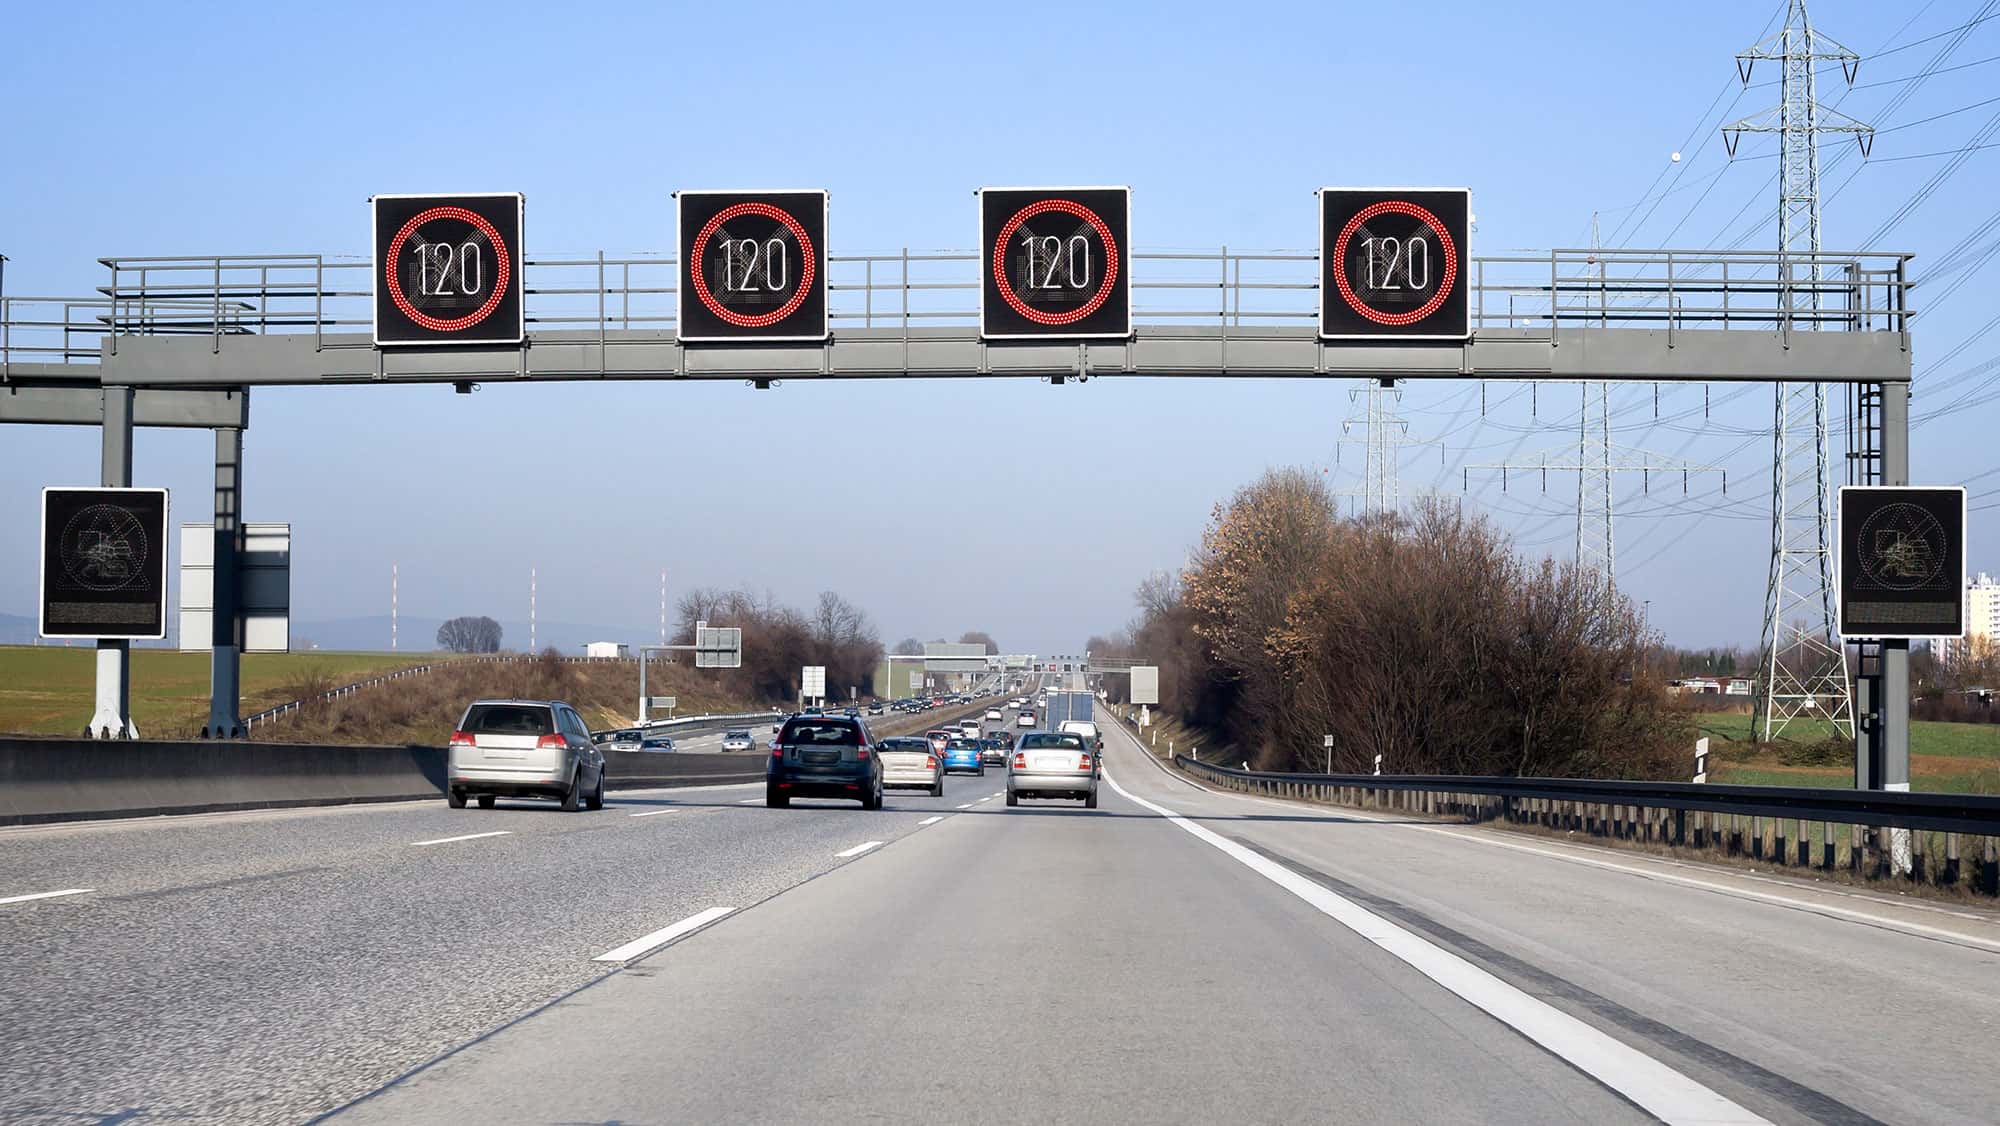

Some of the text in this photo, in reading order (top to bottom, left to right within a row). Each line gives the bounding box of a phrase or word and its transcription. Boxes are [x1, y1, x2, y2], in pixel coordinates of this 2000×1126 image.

[413, 242, 481, 296] 120
[719, 238, 786, 291] 120
[1021, 235, 1089, 289] 120
[1361, 236, 1428, 290] 120
